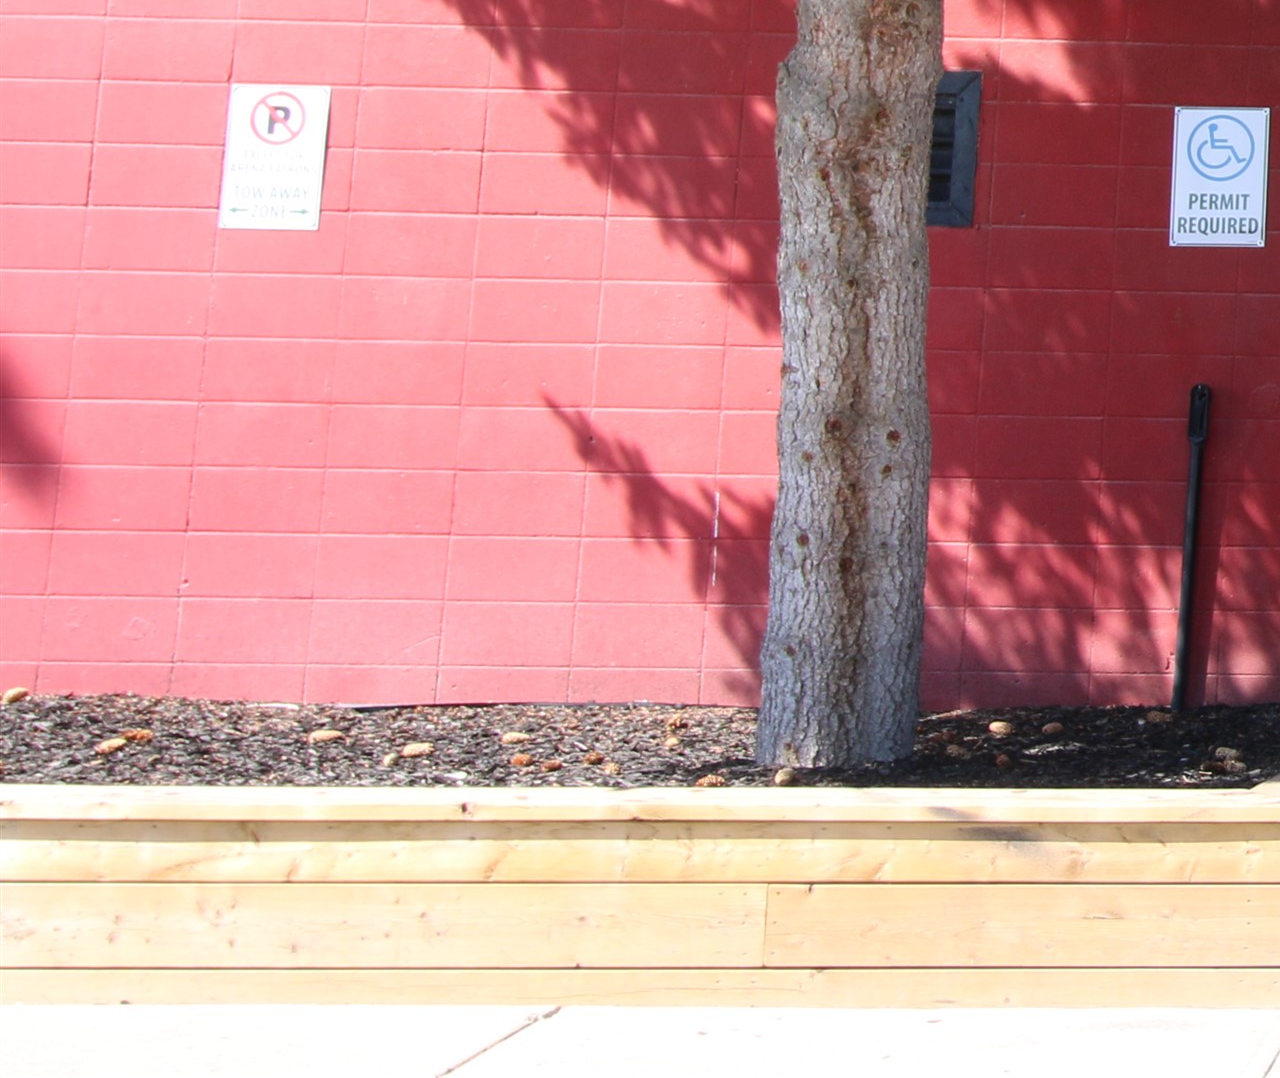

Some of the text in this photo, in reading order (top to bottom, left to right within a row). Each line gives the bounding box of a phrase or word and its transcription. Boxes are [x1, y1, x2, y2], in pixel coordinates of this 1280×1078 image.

[235, 185, 309, 200] TOW AWAY
[1188, 193, 1250, 211] PERMIT
[251, 204, 287, 219] ZONE
[1177, 217, 1259, 235] REQUIRED
